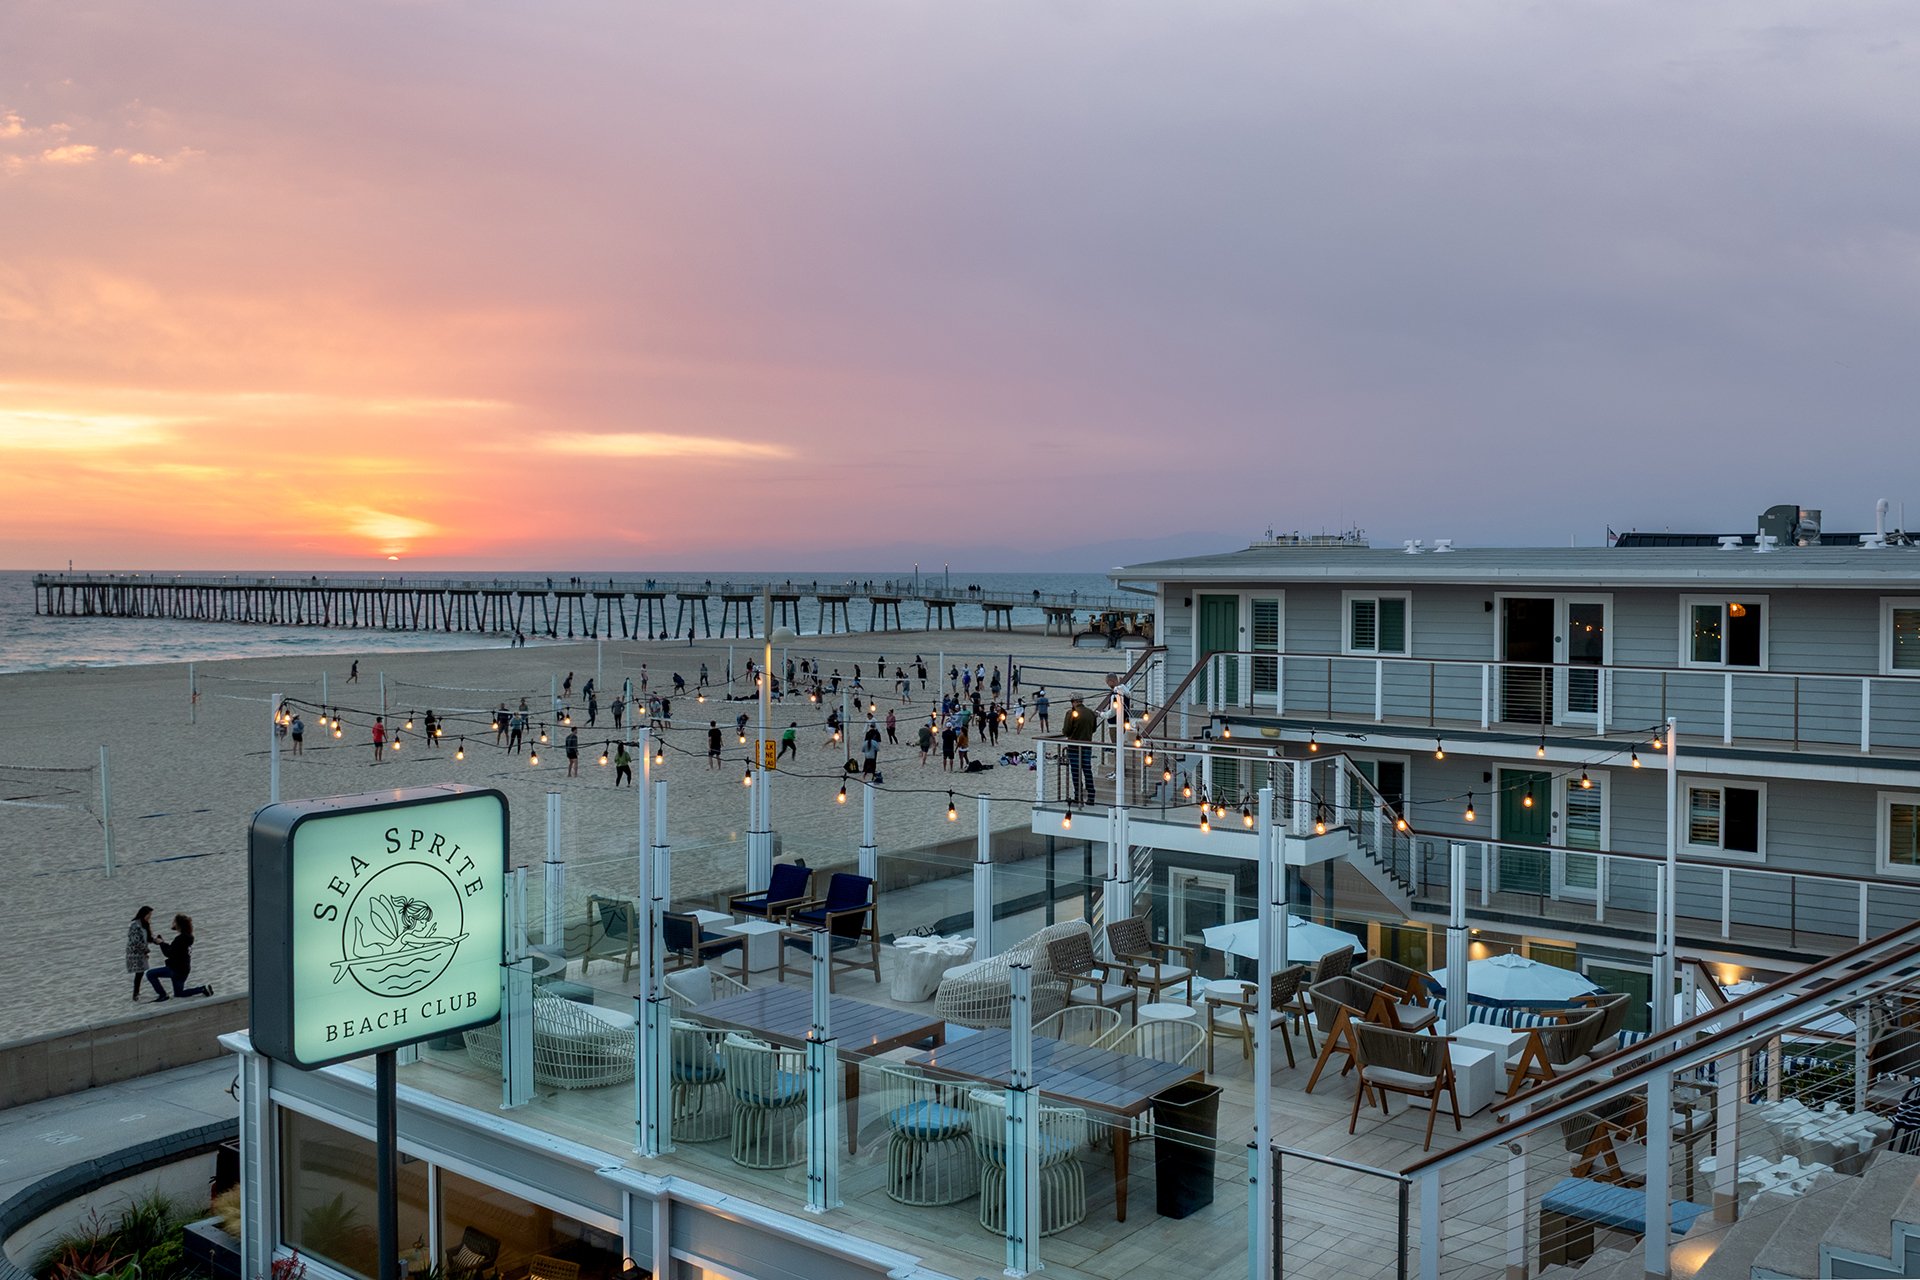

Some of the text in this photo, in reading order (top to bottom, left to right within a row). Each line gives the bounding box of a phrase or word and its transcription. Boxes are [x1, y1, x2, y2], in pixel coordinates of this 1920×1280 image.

[314, 827, 484, 922] SEA SPRITE
[326, 991, 478, 1042] BEACH CLUB
